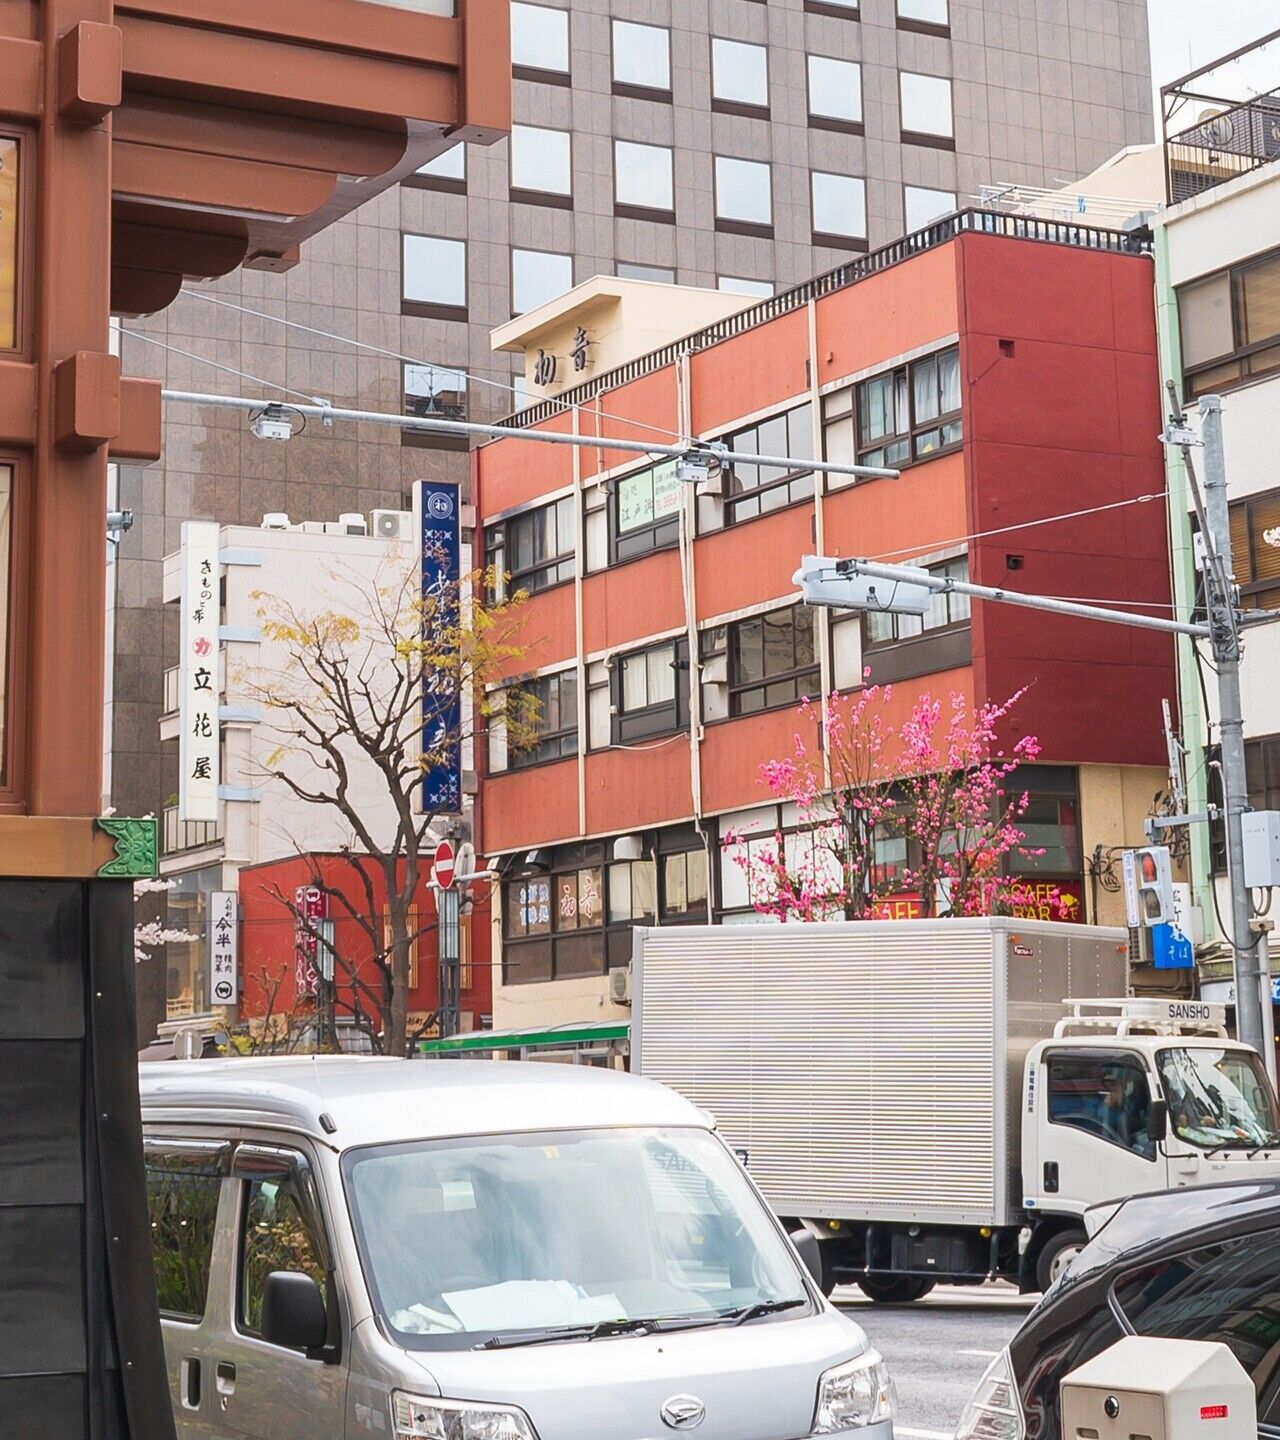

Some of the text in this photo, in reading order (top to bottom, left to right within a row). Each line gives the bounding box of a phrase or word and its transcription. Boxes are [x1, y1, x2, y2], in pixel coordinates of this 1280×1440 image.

[191, 666, 213, 780] 立花屋
[215, 916, 233, 948] 今半
[1168, 1004, 1210, 1020] SANSHO
